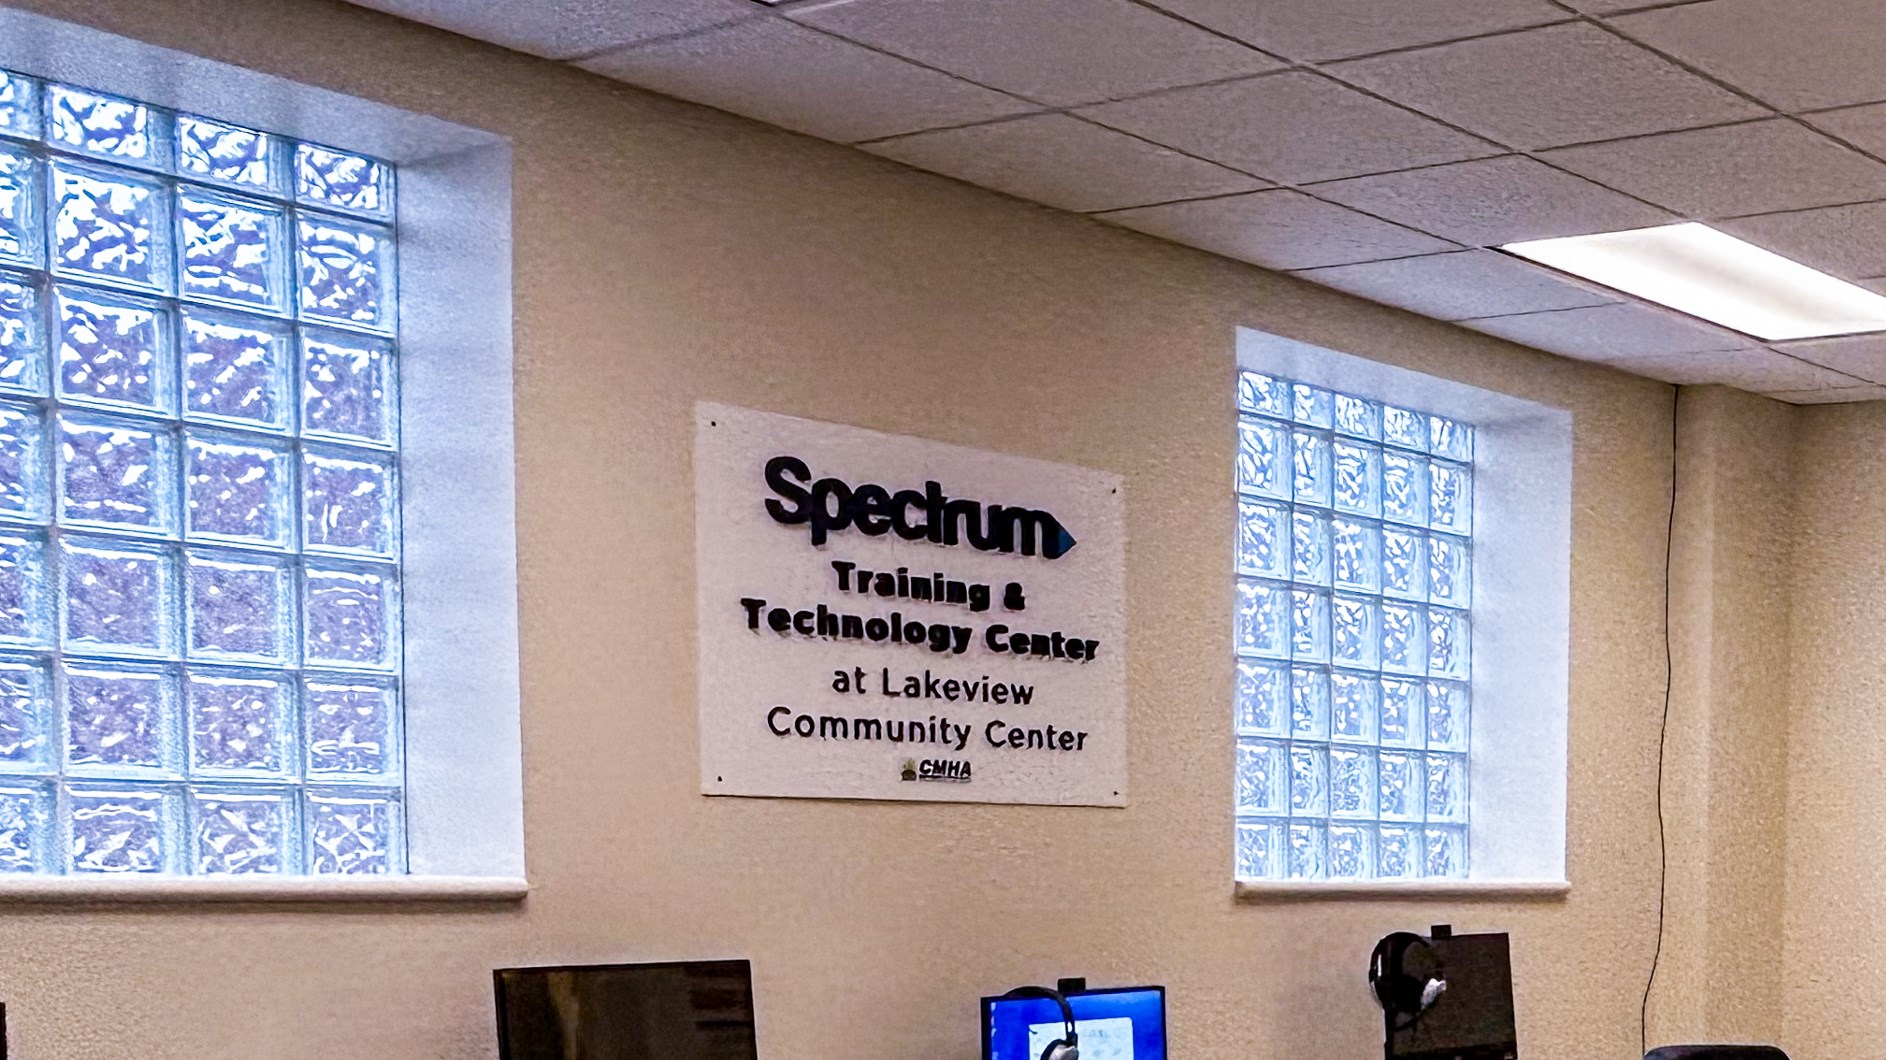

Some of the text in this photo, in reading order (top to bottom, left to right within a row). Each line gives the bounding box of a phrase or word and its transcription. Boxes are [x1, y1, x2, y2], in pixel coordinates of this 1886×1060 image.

[764, 456, 1062, 560] Spectrum
[832, 560, 1026, 612] Training &
[741, 598, 1100, 661] Technology Center
[832, 667, 1035, 706] at Lakeview
[767, 706, 1088, 752] Community Center
[919, 759, 972, 777] CMHA
